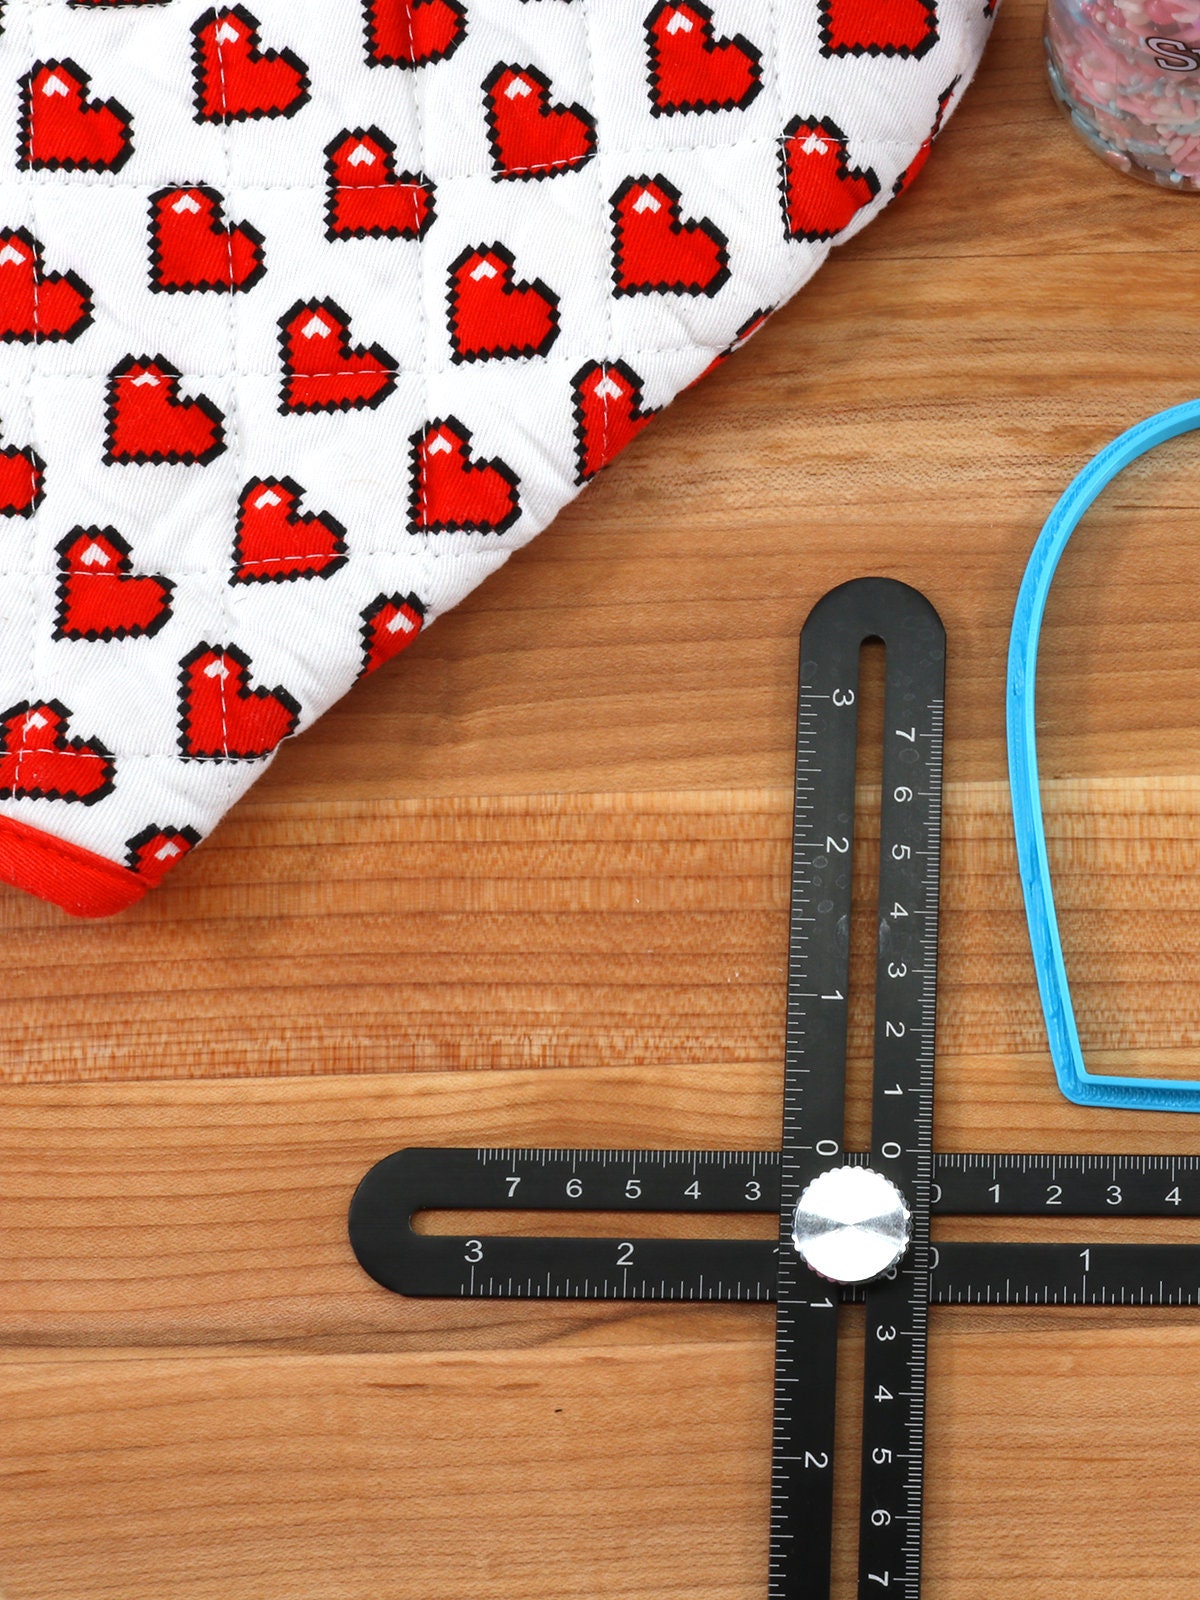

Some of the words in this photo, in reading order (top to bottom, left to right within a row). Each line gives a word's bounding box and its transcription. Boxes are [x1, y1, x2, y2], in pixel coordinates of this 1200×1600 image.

[832, 688, 855, 707] 3
[895, 726, 916, 743] 7
[893, 785, 914, 803] 6
[825, 835, 850, 854] 2
[891, 843, 912, 861] 5
[889, 901, 910, 920] 4
[887, 961, 908, 979] 3
[820, 989, 845, 1001] 1
[885, 1020, 906, 1038] 2
[883, 1083, 904, 1096] 1
[815, 1139, 839, 1157] 0
[881, 1141, 902, 1159] 0
[505, 1176, 521, 1198] 7
[565, 1178, 583, 1198] 6
[624, 1179, 642, 1199] 5
[683, 1180, 702, 1200] 4
[744, 1181, 762, 1201] 3
[988, 1183, 1000, 1204] 1
[1045, 1184, 1063, 1205] 2
[1106, 1185, 1123, 1205] 3
[1164, 1186, 1182, 1206] 4
[464, 1239, 484, 1263] 3
[616, 1242, 635, 1266] 2
[1079, 1248, 1090, 1272] 1
[809, 1297, 834, 1308] 1
[876, 1324, 897, 1342] 3
[874, 1384, 894, 1403] 4
[804, 1450, 829, 1469] 2
[871, 1447, 892, 1465] 5
[870, 1509, 891, 1527] 6
[867, 1570, 889, 1587] 7
